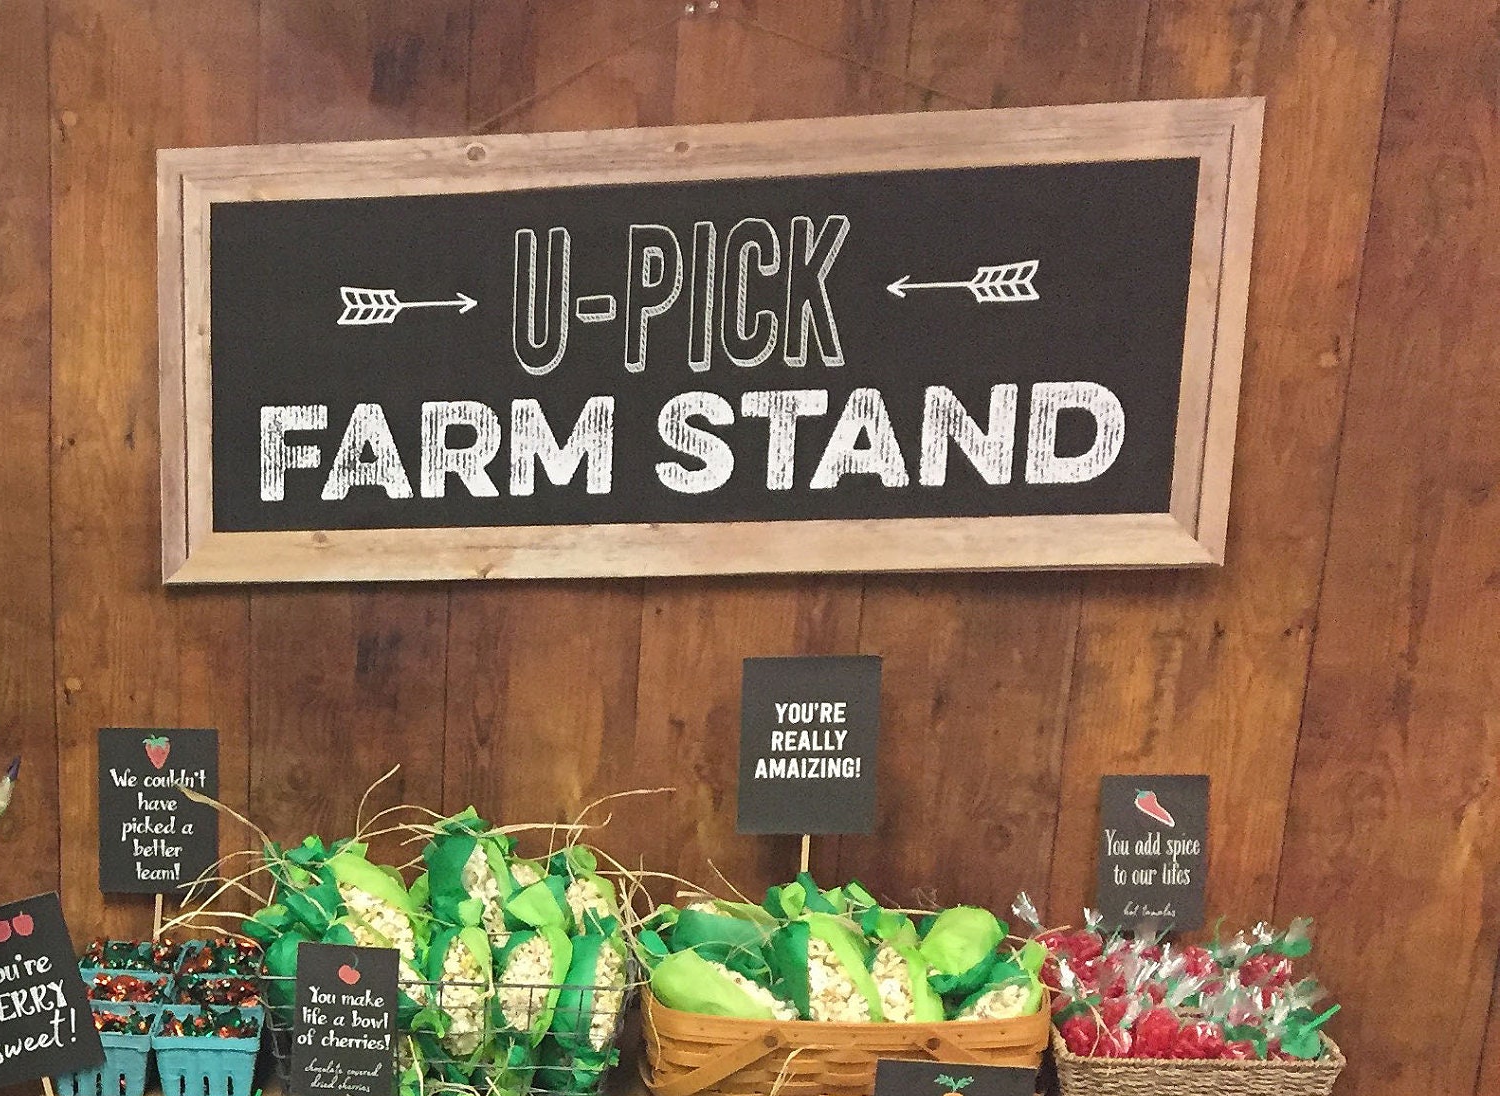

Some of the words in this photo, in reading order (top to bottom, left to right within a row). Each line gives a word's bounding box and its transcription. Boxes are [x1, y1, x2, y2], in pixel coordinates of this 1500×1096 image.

[511, 213, 852, 378] U-PICK
[257, 395, 617, 503] FARM
[654, 378, 1127, 494] STAND
[775, 702, 847, 724] YOU'RE
[771, 730, 848, 752] REALLY
[109, 768, 138, 788] We
[143, 768, 206, 789] couldn't
[754, 757, 862, 779] AMAIZING!
[137, 792, 178, 811] have
[121, 816, 176, 842] picked
[181, 822, 194, 835] a
[132, 838, 183, 858] better
[1104, 829, 1130, 856] You
[1135, 831, 1162, 857] add
[1166, 832, 1201, 863] spice
[136, 861, 181, 881] team!
[1114, 864, 1128, 886] to
[1132, 869, 1158, 886] our
[309, 985, 336, 1004] You
[341, 989, 385, 1008] make
[302, 1006, 328, 1025] life
[333, 1016, 346, 1027] a
[351, 1010, 389, 1029] bowl
[297, 1028, 317, 1046] of
[321, 1029, 392, 1051] cherries!
